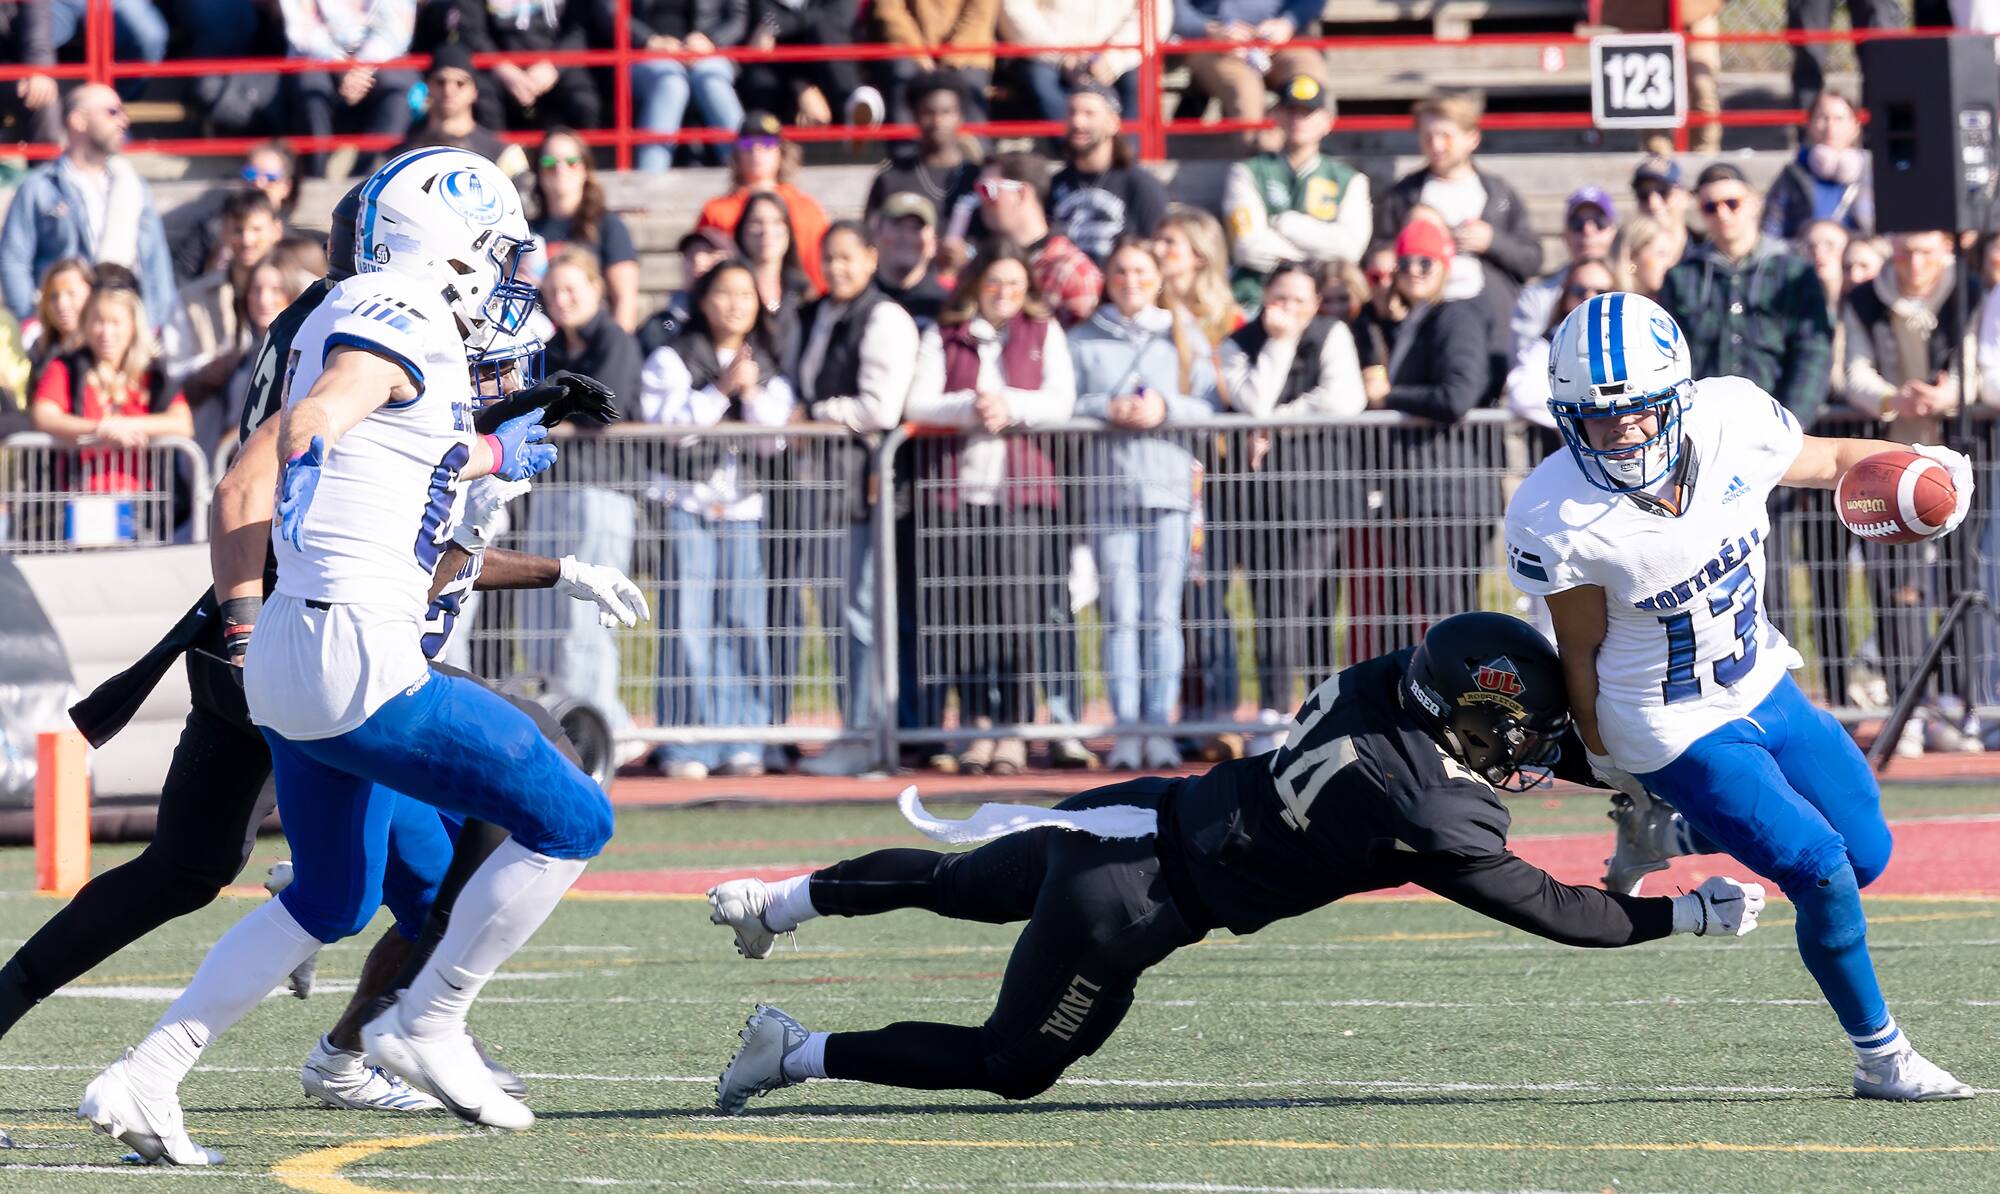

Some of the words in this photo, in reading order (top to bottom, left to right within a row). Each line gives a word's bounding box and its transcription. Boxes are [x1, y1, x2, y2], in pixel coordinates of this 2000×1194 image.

[1604, 52, 1673, 110] 123
[1846, 498, 1888, 513] Wilson
[1657, 562, 1758, 706] 13
[1410, 680, 1440, 717] RSEQ
[1478, 666, 1522, 695] UL
[1040, 974, 1102, 1041] LAVAL
